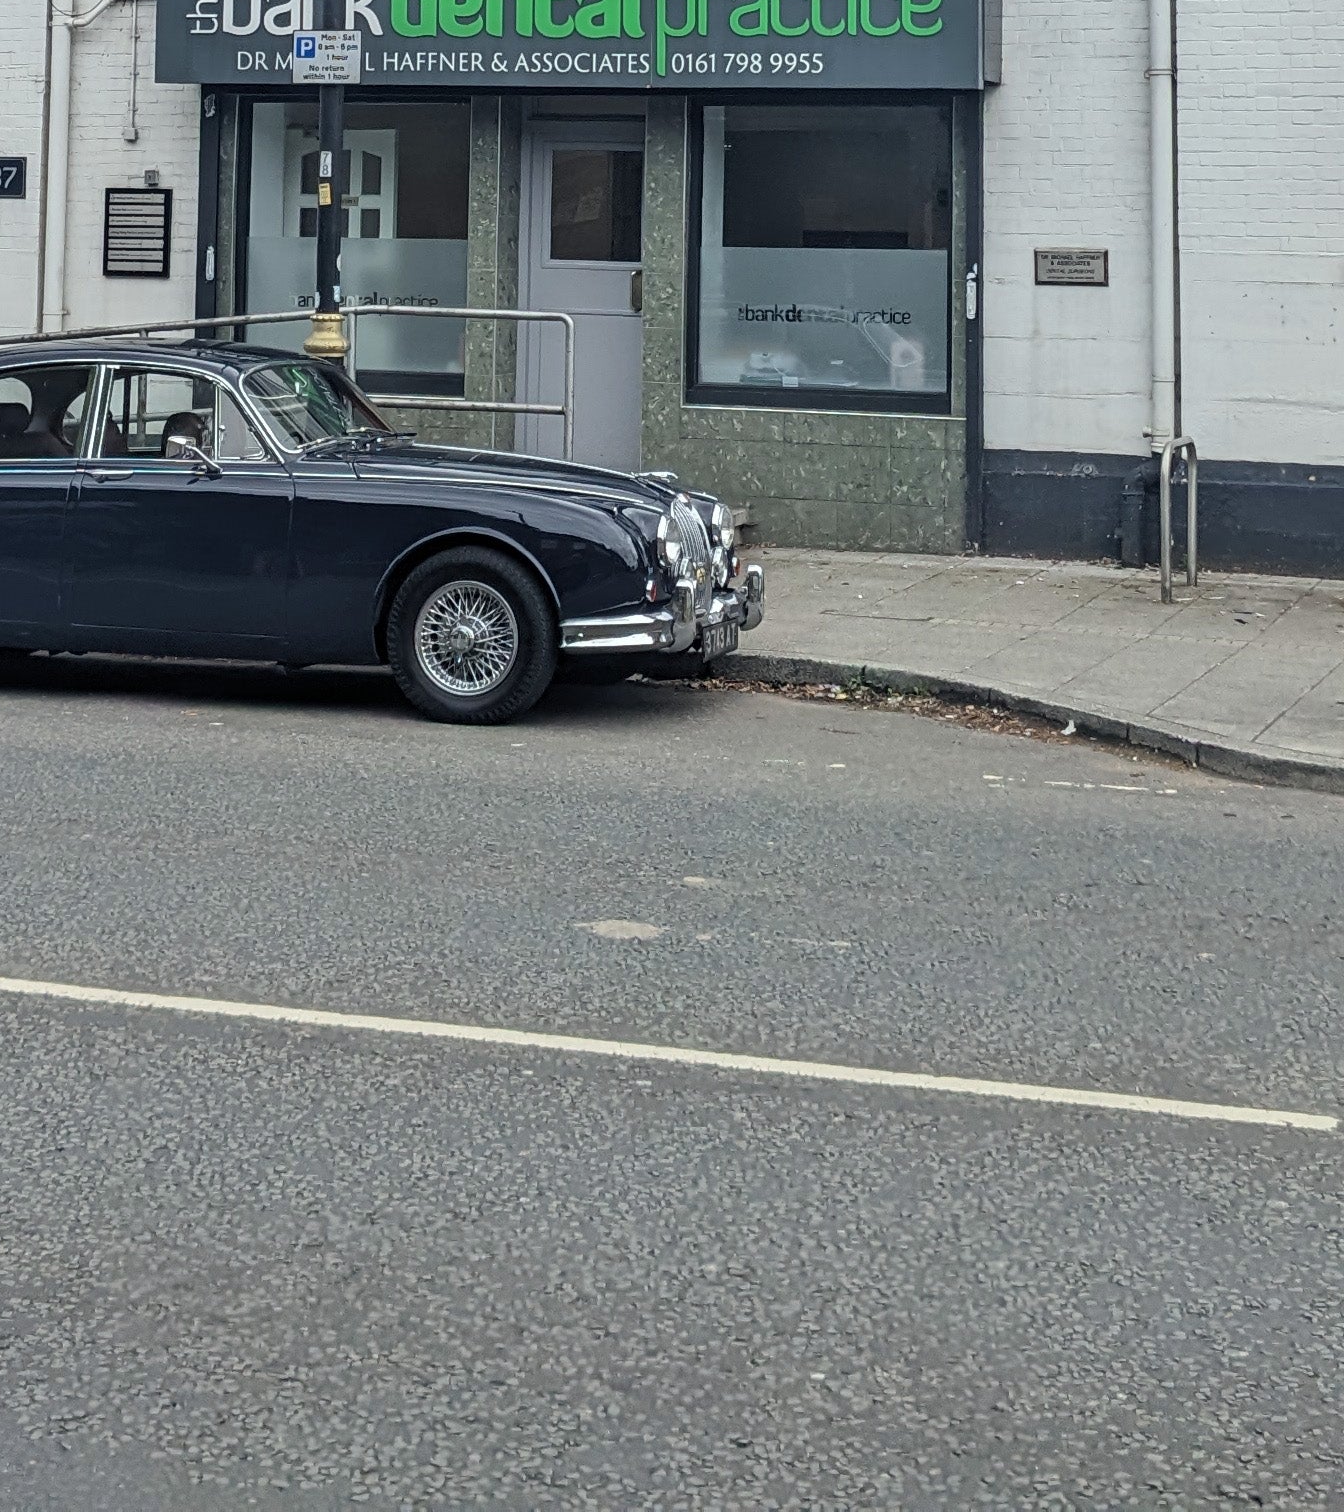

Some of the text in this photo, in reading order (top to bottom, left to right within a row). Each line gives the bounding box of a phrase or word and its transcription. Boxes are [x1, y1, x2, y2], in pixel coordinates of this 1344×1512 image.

[301, 40, 312, 56] P
[237, 51, 269, 70] DR
[383, 52, 483, 71] HAFFNER
[491, 52, 508, 72] &
[514, 52, 650, 74] ASSOCIATES
[671, 52, 716, 74] 0161
[723, 52, 762, 74] 798
[770, 52, 824, 74] 9955
